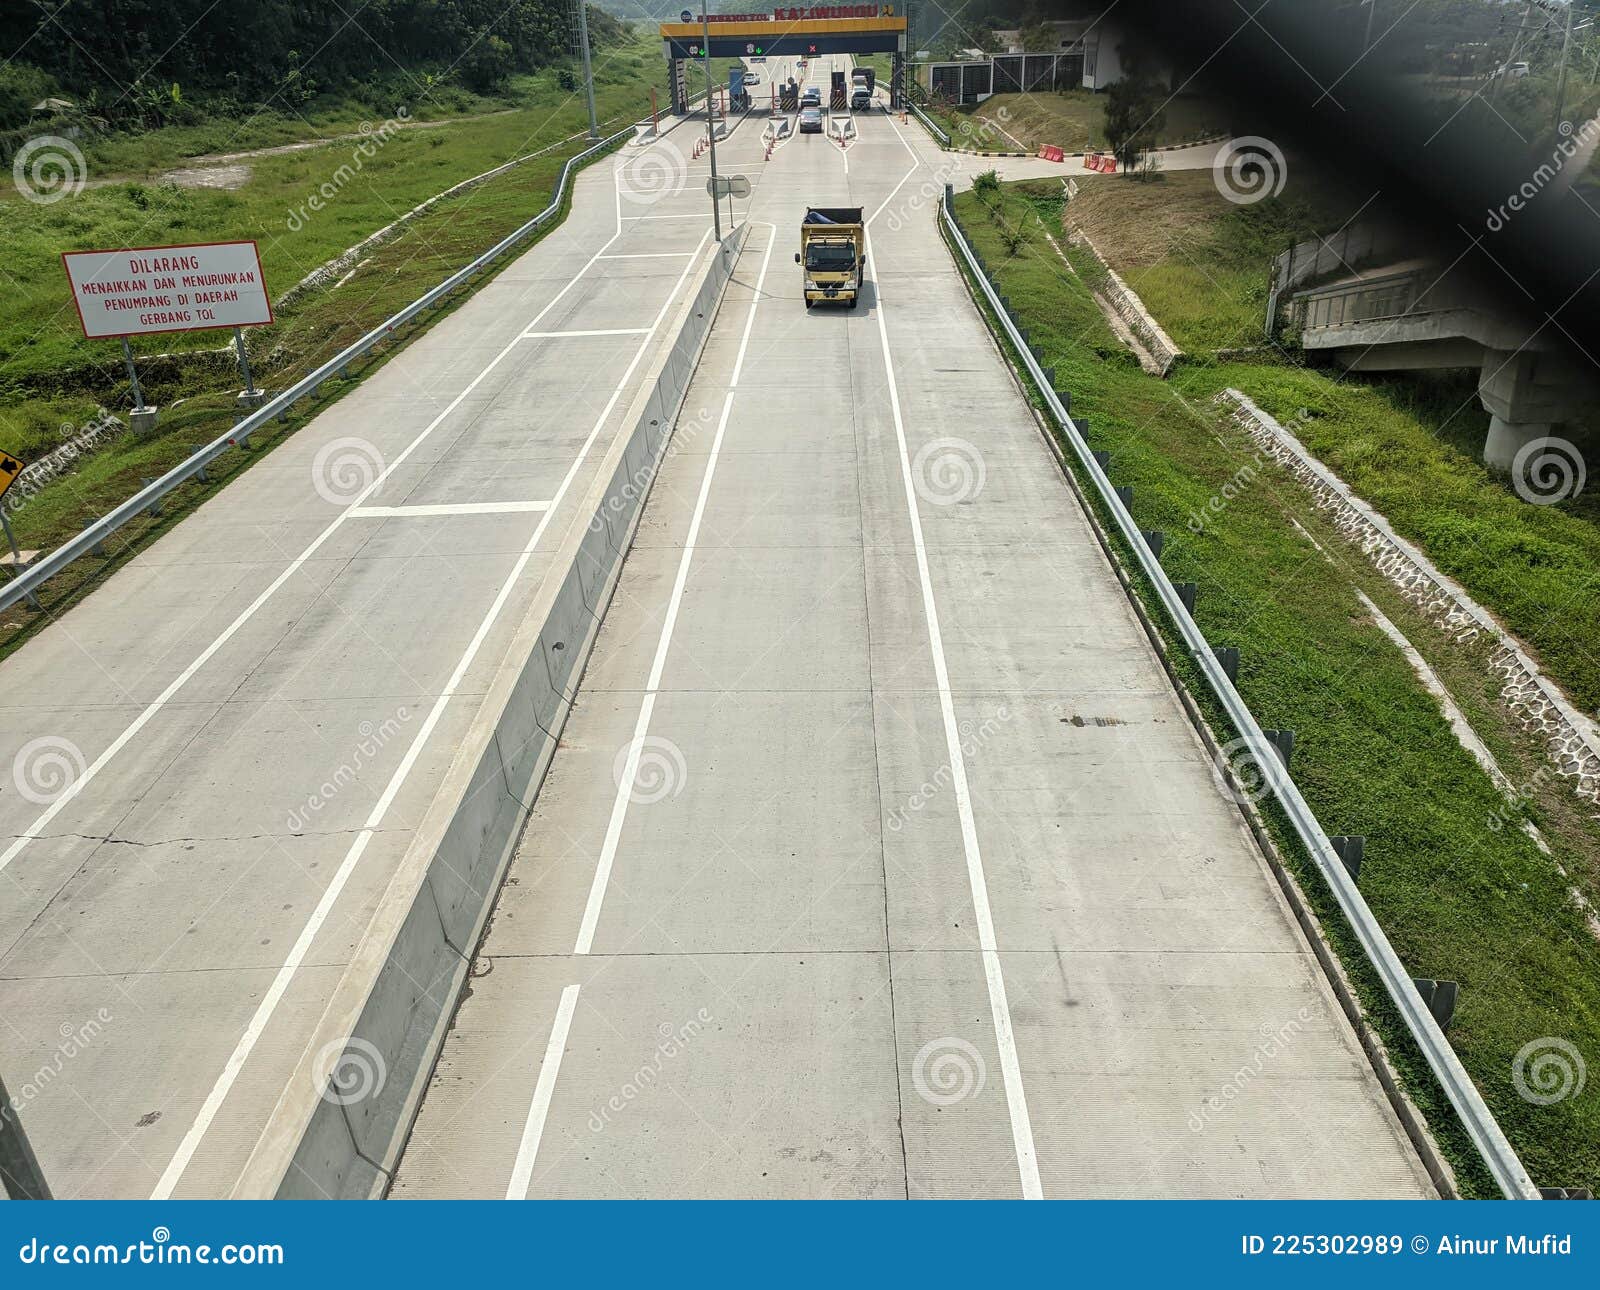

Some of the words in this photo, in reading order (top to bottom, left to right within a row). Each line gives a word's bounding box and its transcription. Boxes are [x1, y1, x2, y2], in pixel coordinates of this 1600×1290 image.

[130, 256, 199, 274] DILARANG
[82, 279, 147, 294] MENAIKKAN
[154, 278, 176, 290] DAN
[182, 272, 254, 288] MENURUNKAN
[104, 295, 171, 311] PENUMPANG
[178, 294, 189, 305] DI
[195, 290, 238, 304] DAERAH
[140, 310, 191, 325] GERBANG
[196, 309, 216, 320] TOL
